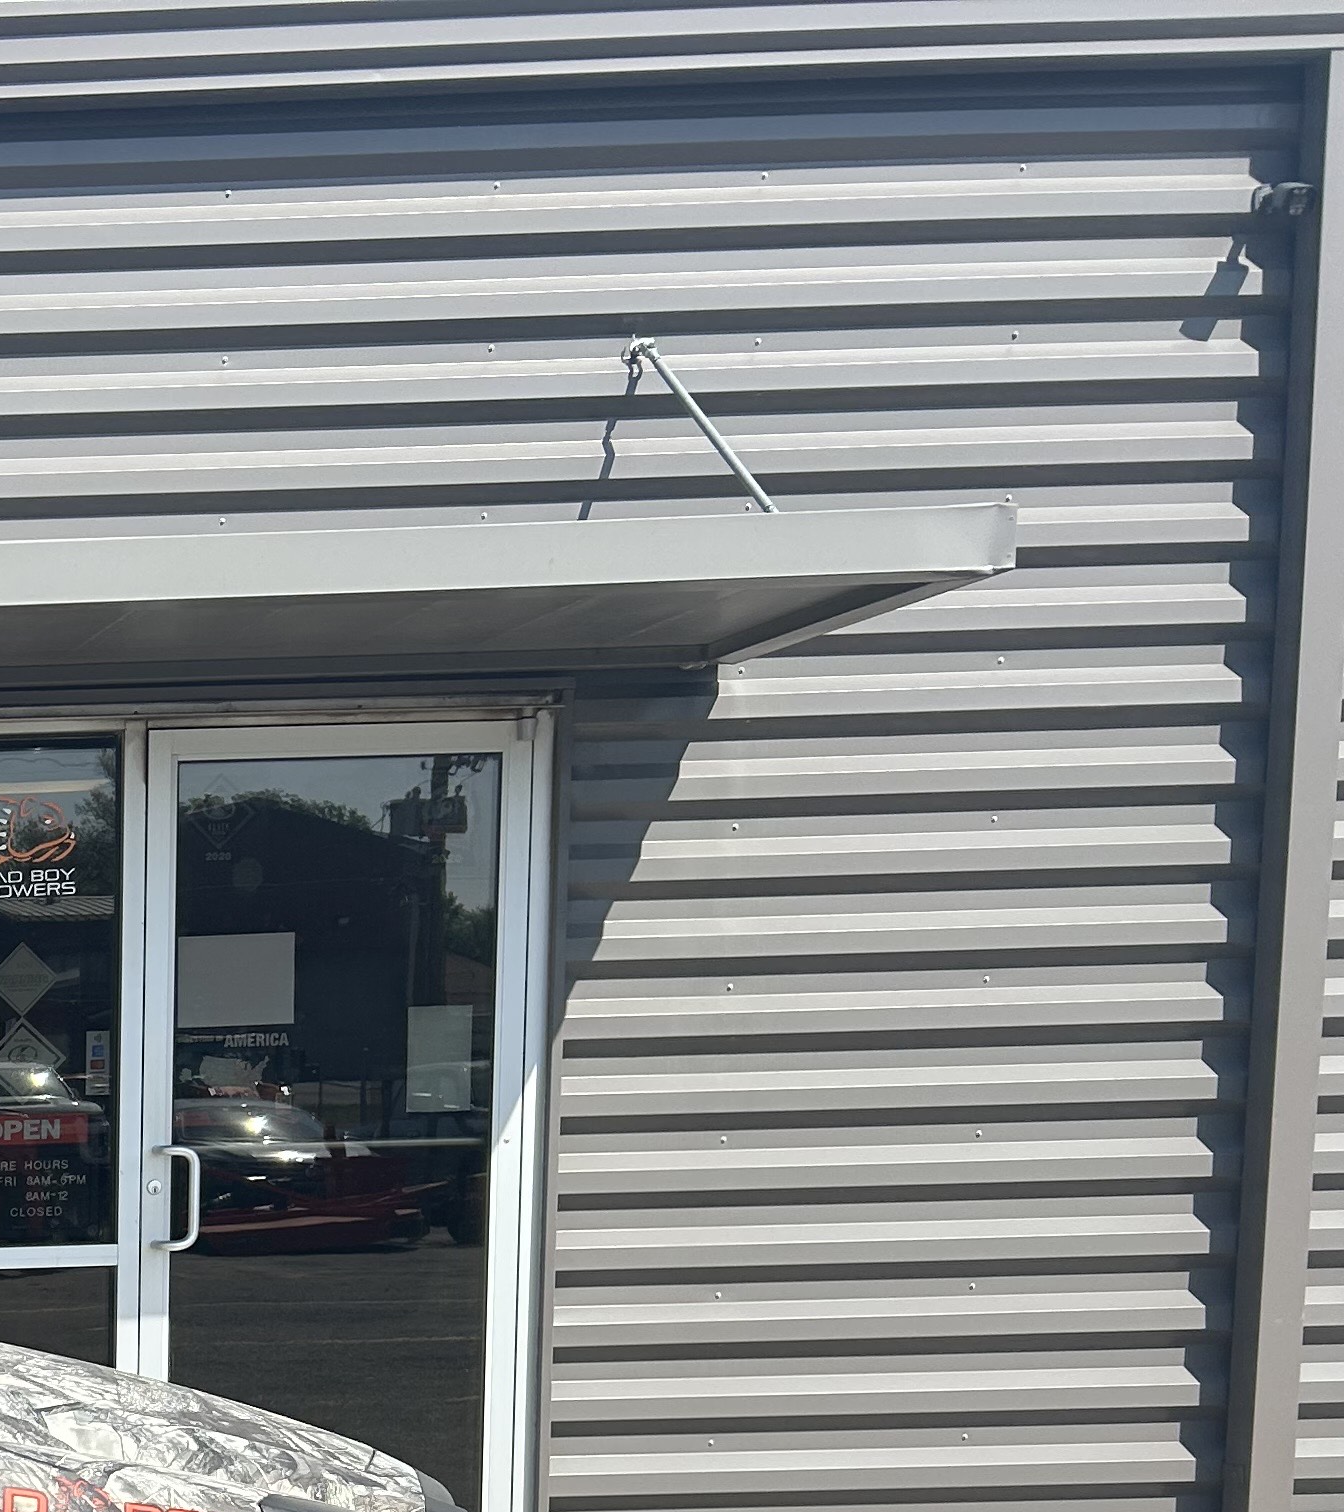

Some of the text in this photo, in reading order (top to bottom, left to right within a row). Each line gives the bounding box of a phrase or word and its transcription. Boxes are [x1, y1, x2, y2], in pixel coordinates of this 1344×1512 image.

[30, 867, 75, 882] BOY
[223, 1032, 289, 1048] AMERICA
[24, 1160, 69, 1171] HOURS
[10, 1206, 63, 1218] CLOSED
